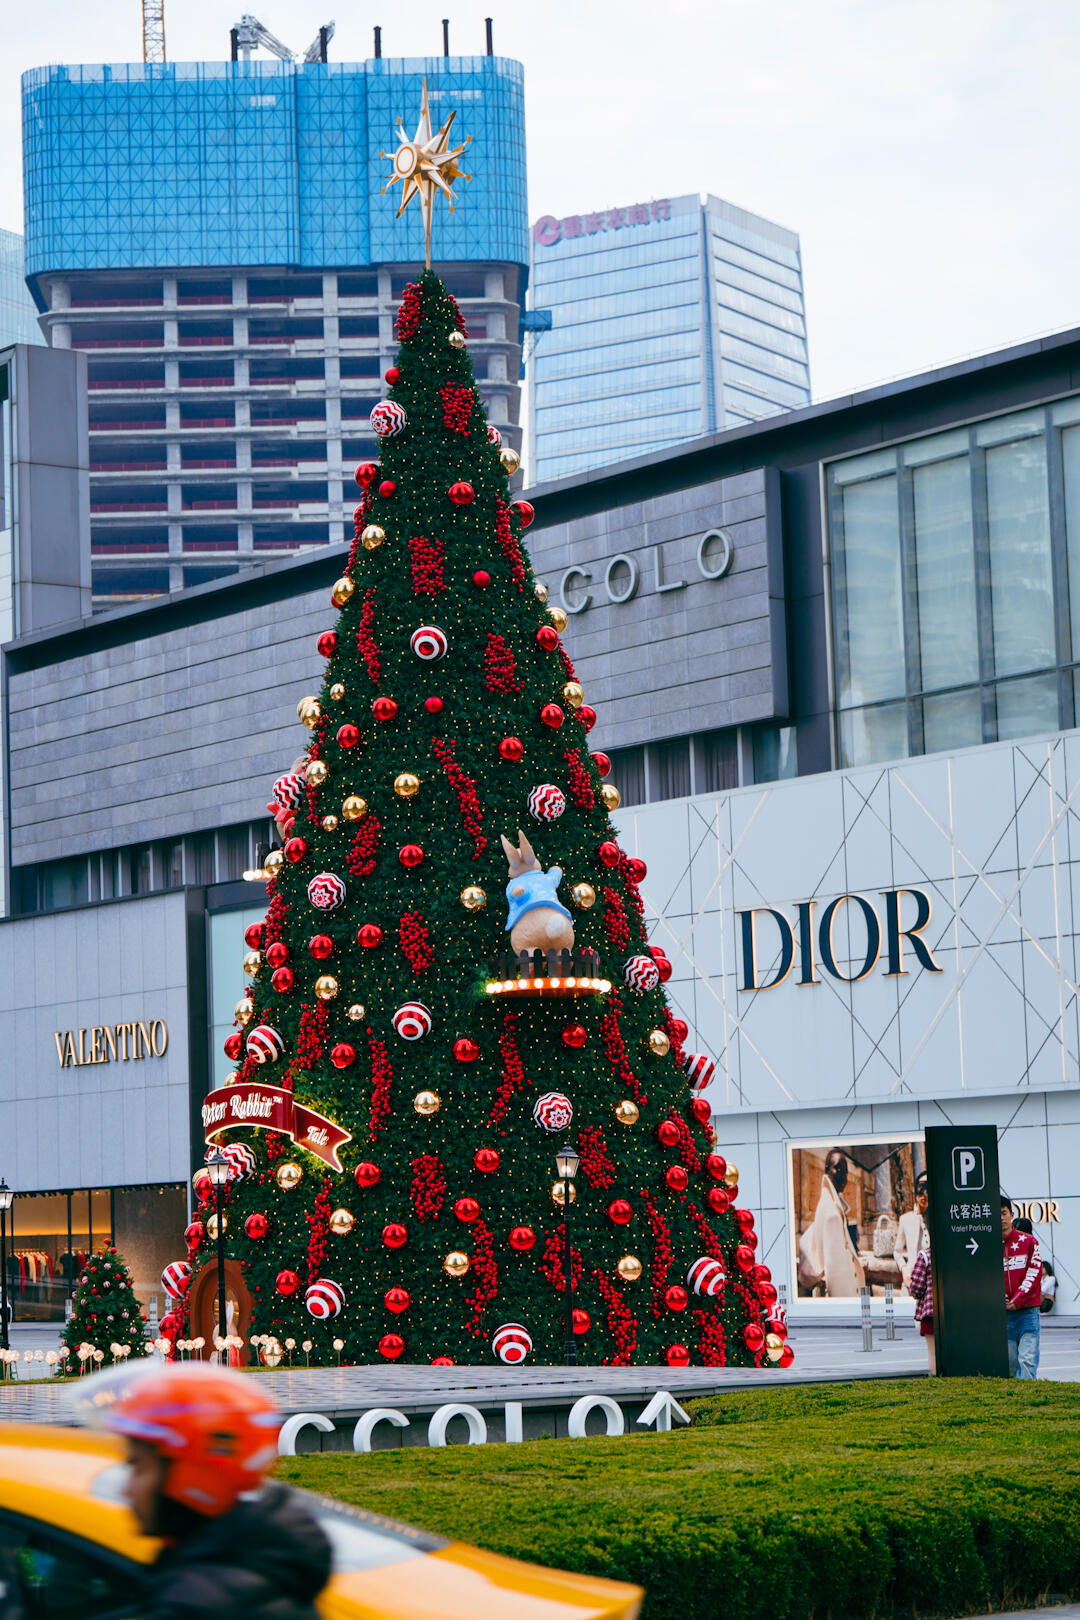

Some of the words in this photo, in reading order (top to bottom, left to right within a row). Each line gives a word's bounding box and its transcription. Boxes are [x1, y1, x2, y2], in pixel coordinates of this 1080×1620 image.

[734, 889, 944, 993] DIOR
[54, 1019, 168, 1068] VALENTINO
[307, 1125, 329, 1146] Tale
[960, 1151, 976, 1186] P
[950, 1203, 992, 1220] 代客泊车
[968, 1224, 992, 1232] Parking
